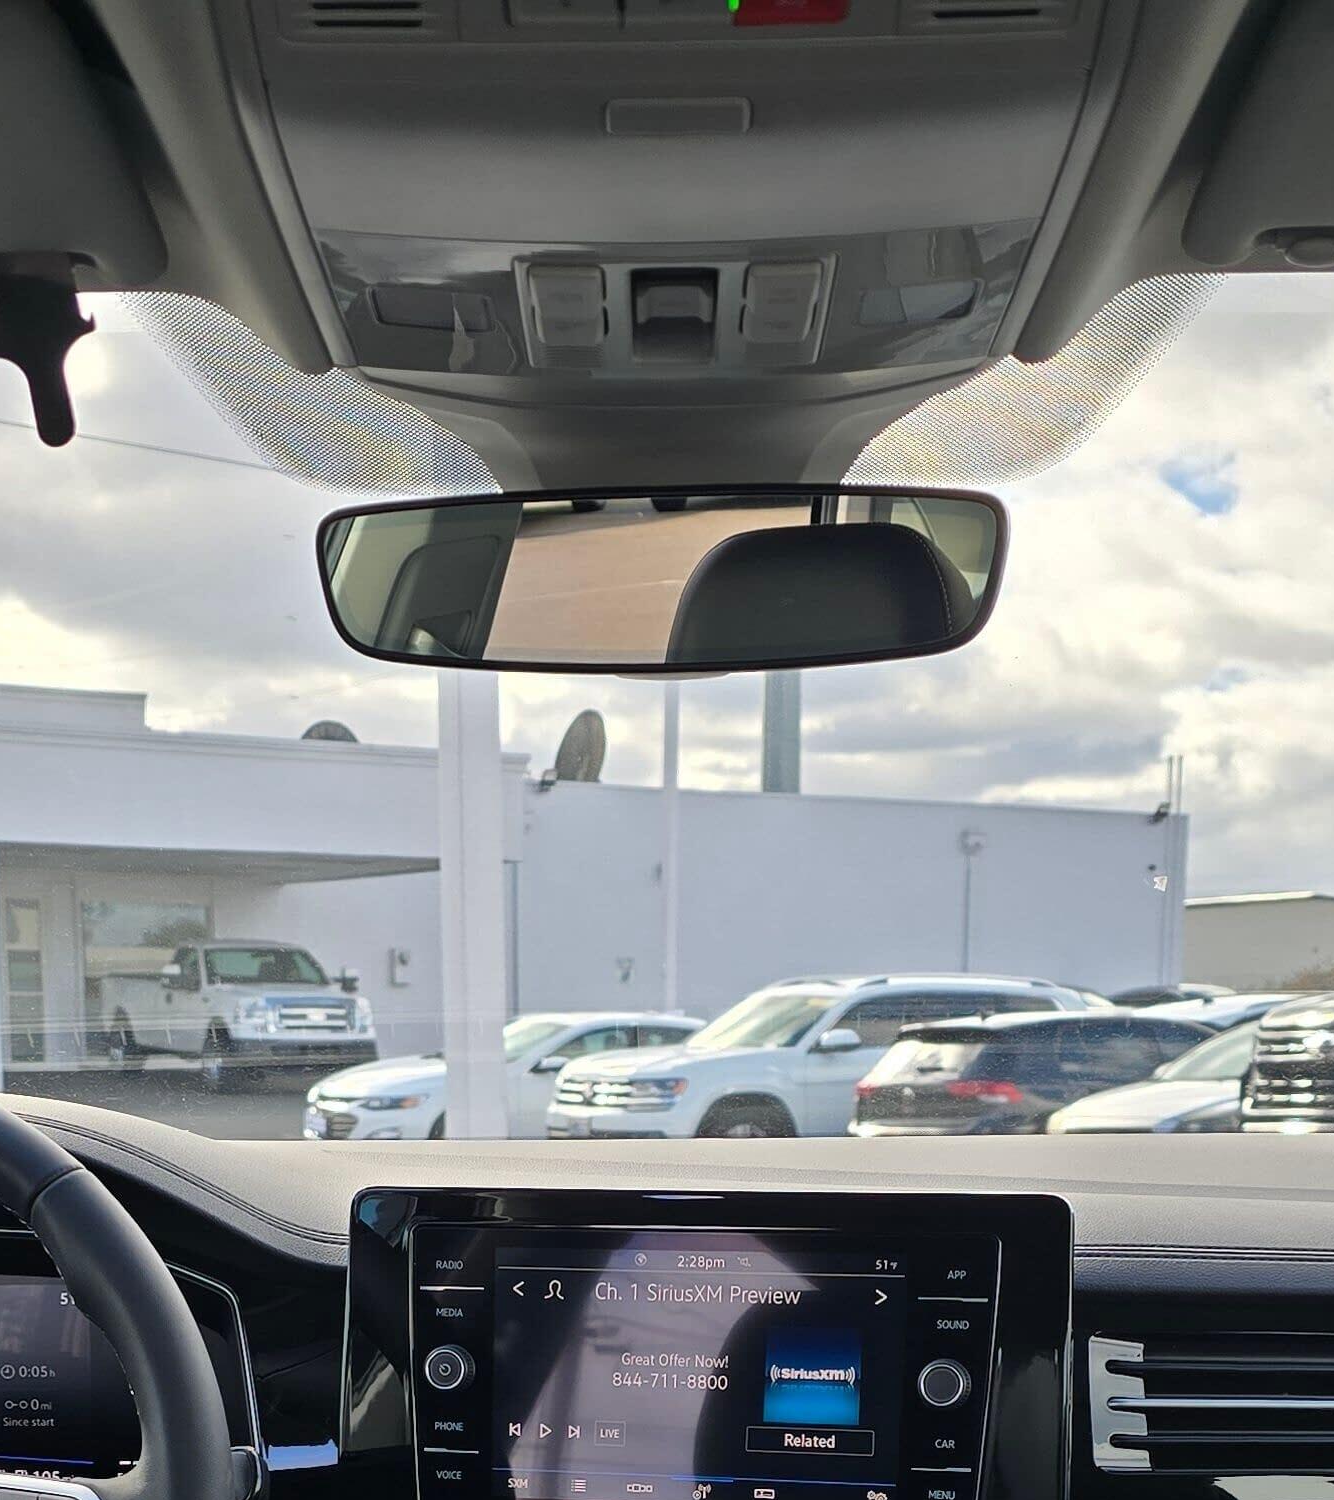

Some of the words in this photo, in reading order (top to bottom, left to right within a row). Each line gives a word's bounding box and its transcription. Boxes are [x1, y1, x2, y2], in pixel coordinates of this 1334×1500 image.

[436, 1260, 463, 1270] RADIO
[677, 1256, 725, 1269] 2:28pm
[947, 1270, 967, 1280] APP
[595, 1282, 622, 1300] Ch.
[631, 1283, 637, 1300] 1
[647, 1284, 722, 1304] SiriusXM
[730, 1286, 801, 1305] Preview
[436, 1308, 463, 1318] MEDIA
[937, 1319, 969, 1330] SOUND
[621, 1353, 655, 1366] Great
[659, 1354, 690, 1368] Offer
[695, 1356, 729, 1368] Now!
[613, 1372, 728, 1390] 844-711-8800
[3, 1418, 29, 1427] Since
[31, 1418, 55, 1427] start
[435, 1422, 464, 1431] PHONE
[600, 1428, 619, 1439] LIVE
[784, 1434, 835, 1449] Related
[935, 1440, 955, 1448] CAR
[436, 1470, 462, 1480] VOICE
[507, 1478, 529, 1489] SXM
[929, 1490, 955, 1500] MENU
